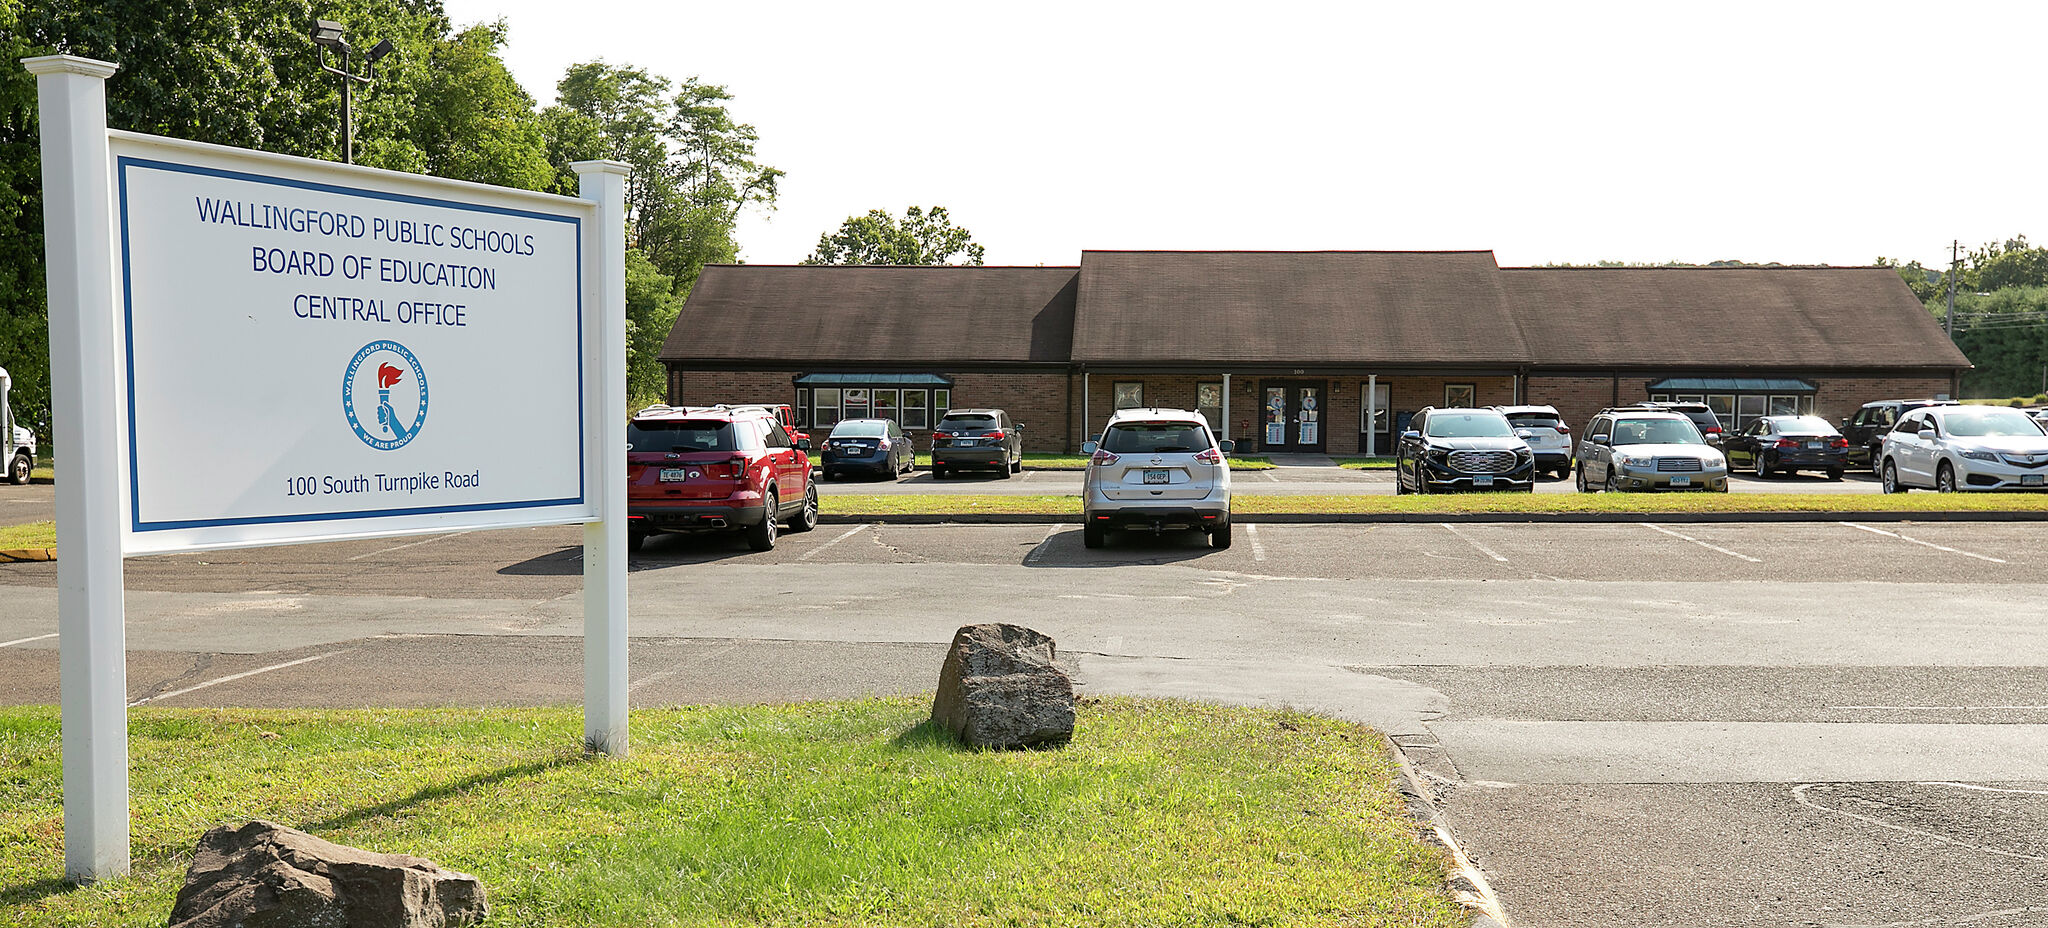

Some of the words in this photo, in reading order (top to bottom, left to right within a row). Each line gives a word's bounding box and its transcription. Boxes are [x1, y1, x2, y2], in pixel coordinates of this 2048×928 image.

[195, 196, 366, 239] WALLINGFORD
[373, 217, 444, 247] PUBLIC
[450, 226, 535, 256] SCHOOLS
[252, 246, 335, 277] BOARD
[342, 254, 372, 280] OF
[380, 258, 496, 291] EDUCATION
[293, 294, 391, 323] CENTRAL
[397, 300, 467, 327] OFFICE
[345, 343, 381, 396] WALLINGFORD
[382, 343, 409, 358] PUBLIC
[408, 356, 426, 397] SCHOOLS
[362, 433, 374, 445] WE
[374, 441, 389, 449] ARE
[390, 432, 413, 449] PROUD
[286, 476, 317, 496] 100
[323, 473, 370, 495] South
[374, 473, 440, 495] Turnpike
[444, 469, 480, 490] Road
